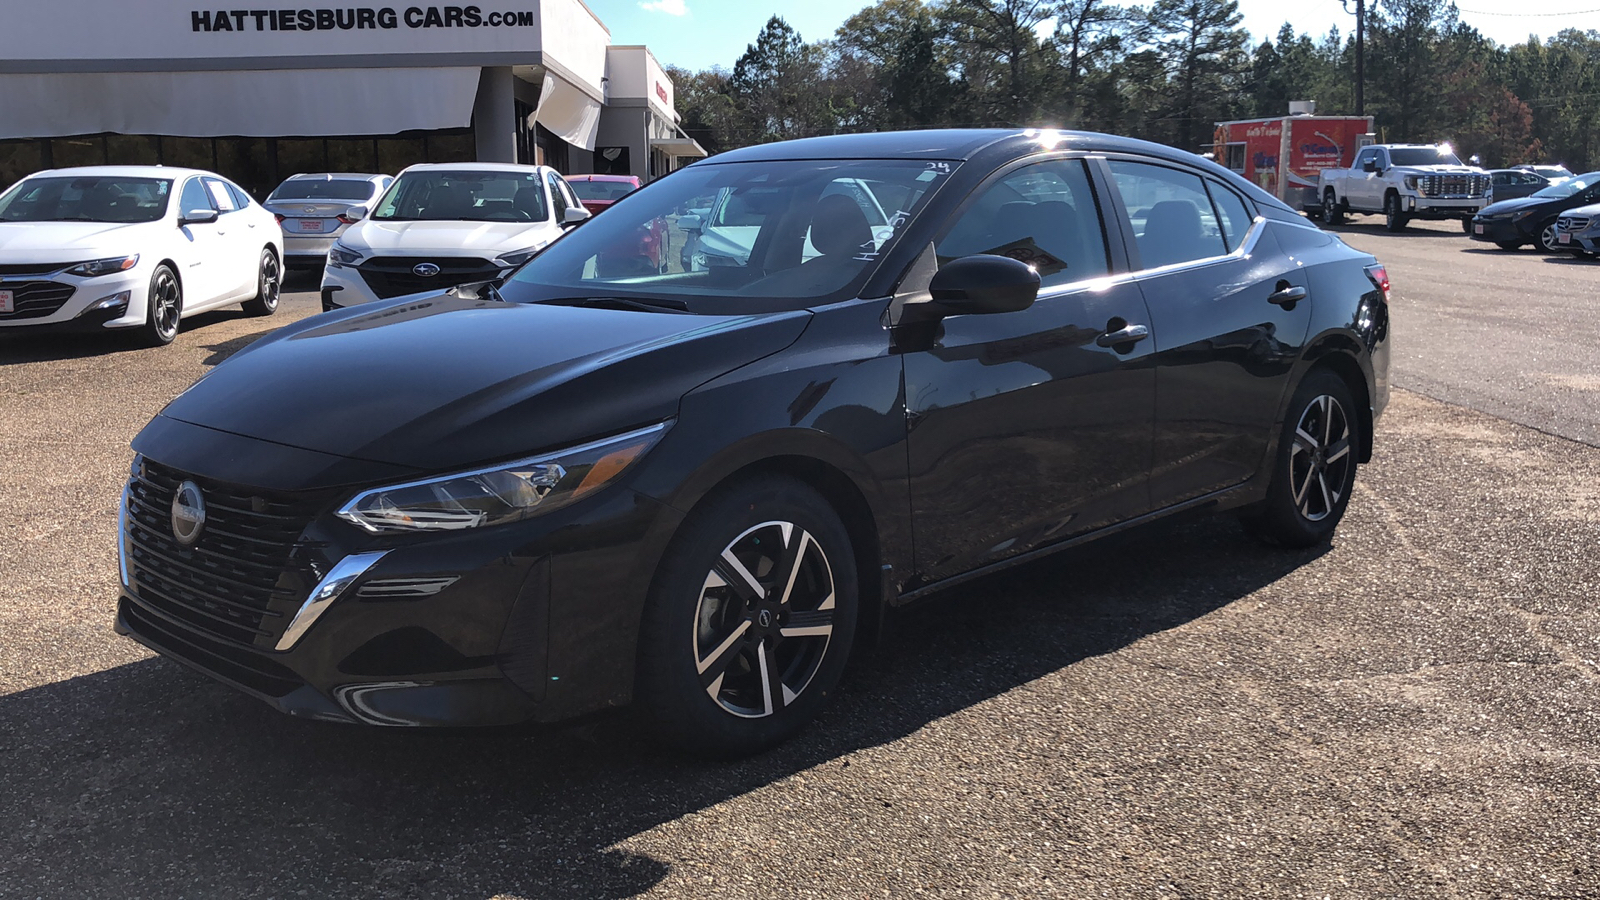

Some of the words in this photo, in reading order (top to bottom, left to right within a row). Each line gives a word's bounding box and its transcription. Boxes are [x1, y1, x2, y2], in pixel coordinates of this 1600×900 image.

[191, 8, 398, 32] HATTIESBURG
[404, 6, 534, 28] CARS.COM
[173, 504, 205, 523] SSAN
